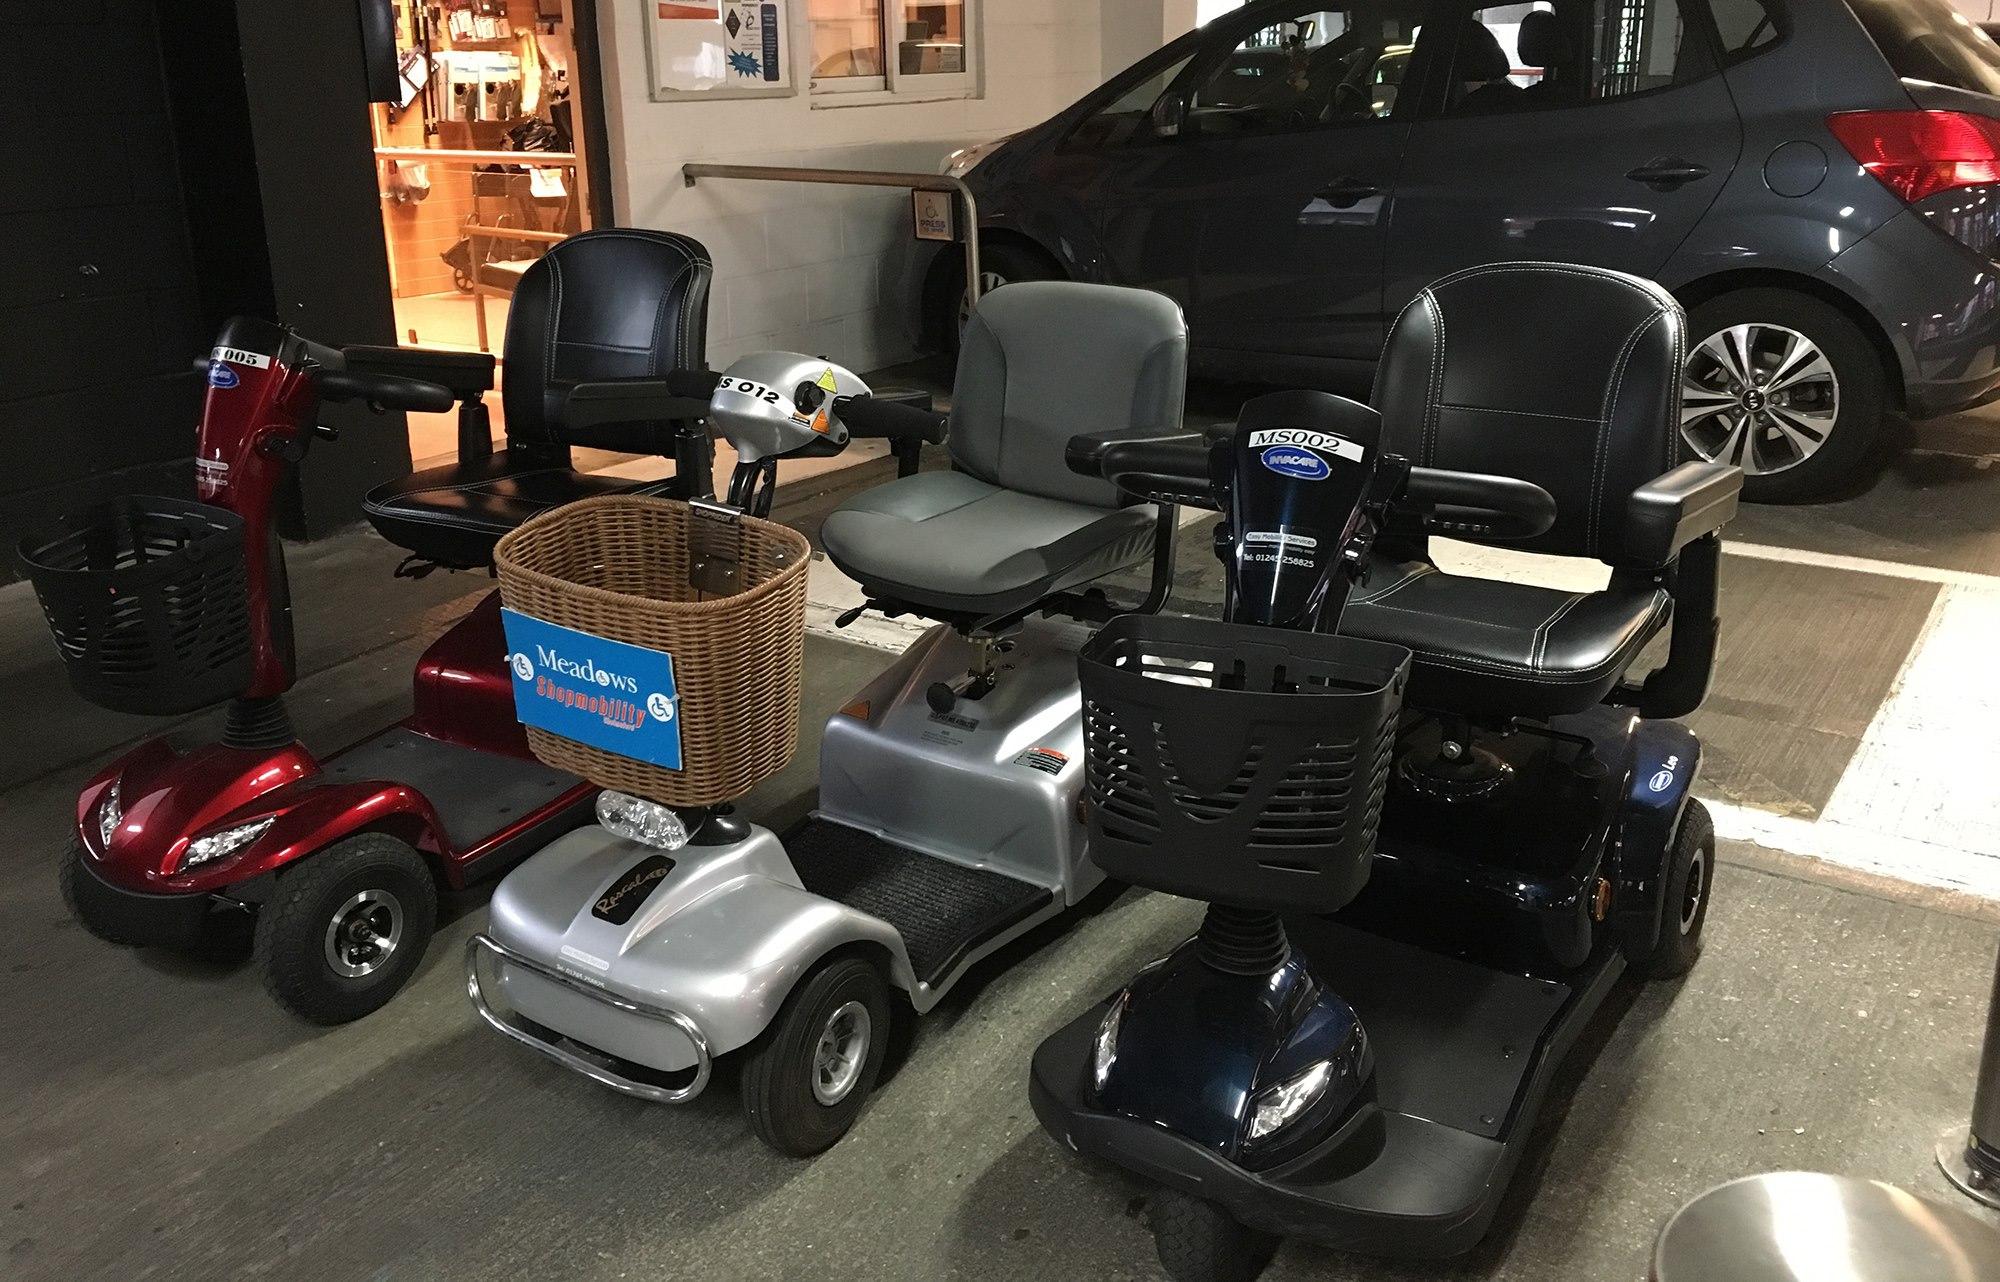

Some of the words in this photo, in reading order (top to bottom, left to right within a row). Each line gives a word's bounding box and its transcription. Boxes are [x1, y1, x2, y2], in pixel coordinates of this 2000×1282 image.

[1256, 431, 1340, 451] MS002
[1287, 535, 1316, 546] Services
[1282, 555, 1315, 568] 258825
[535, 644, 639, 694] Meadows
[536, 675, 647, 729] Shopmobility
